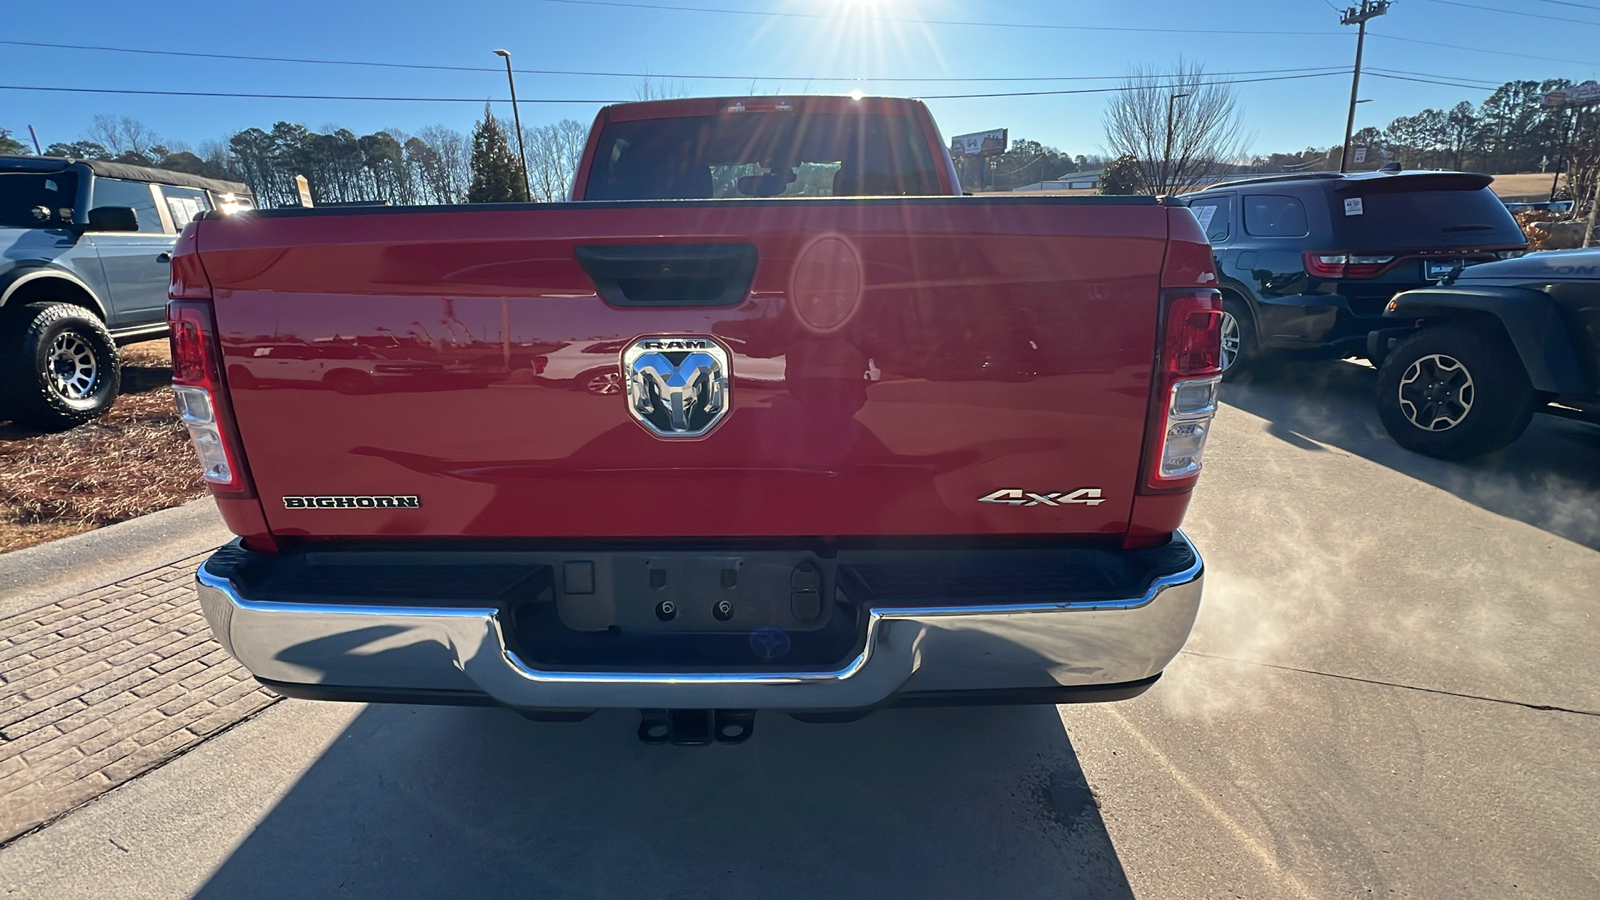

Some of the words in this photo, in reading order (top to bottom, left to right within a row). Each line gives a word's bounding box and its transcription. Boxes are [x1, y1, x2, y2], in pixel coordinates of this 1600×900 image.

[644, 341, 706, 350] RAM
[282, 496, 420, 509] BIGHORN
[977, 488, 1106, 507] 4x4
